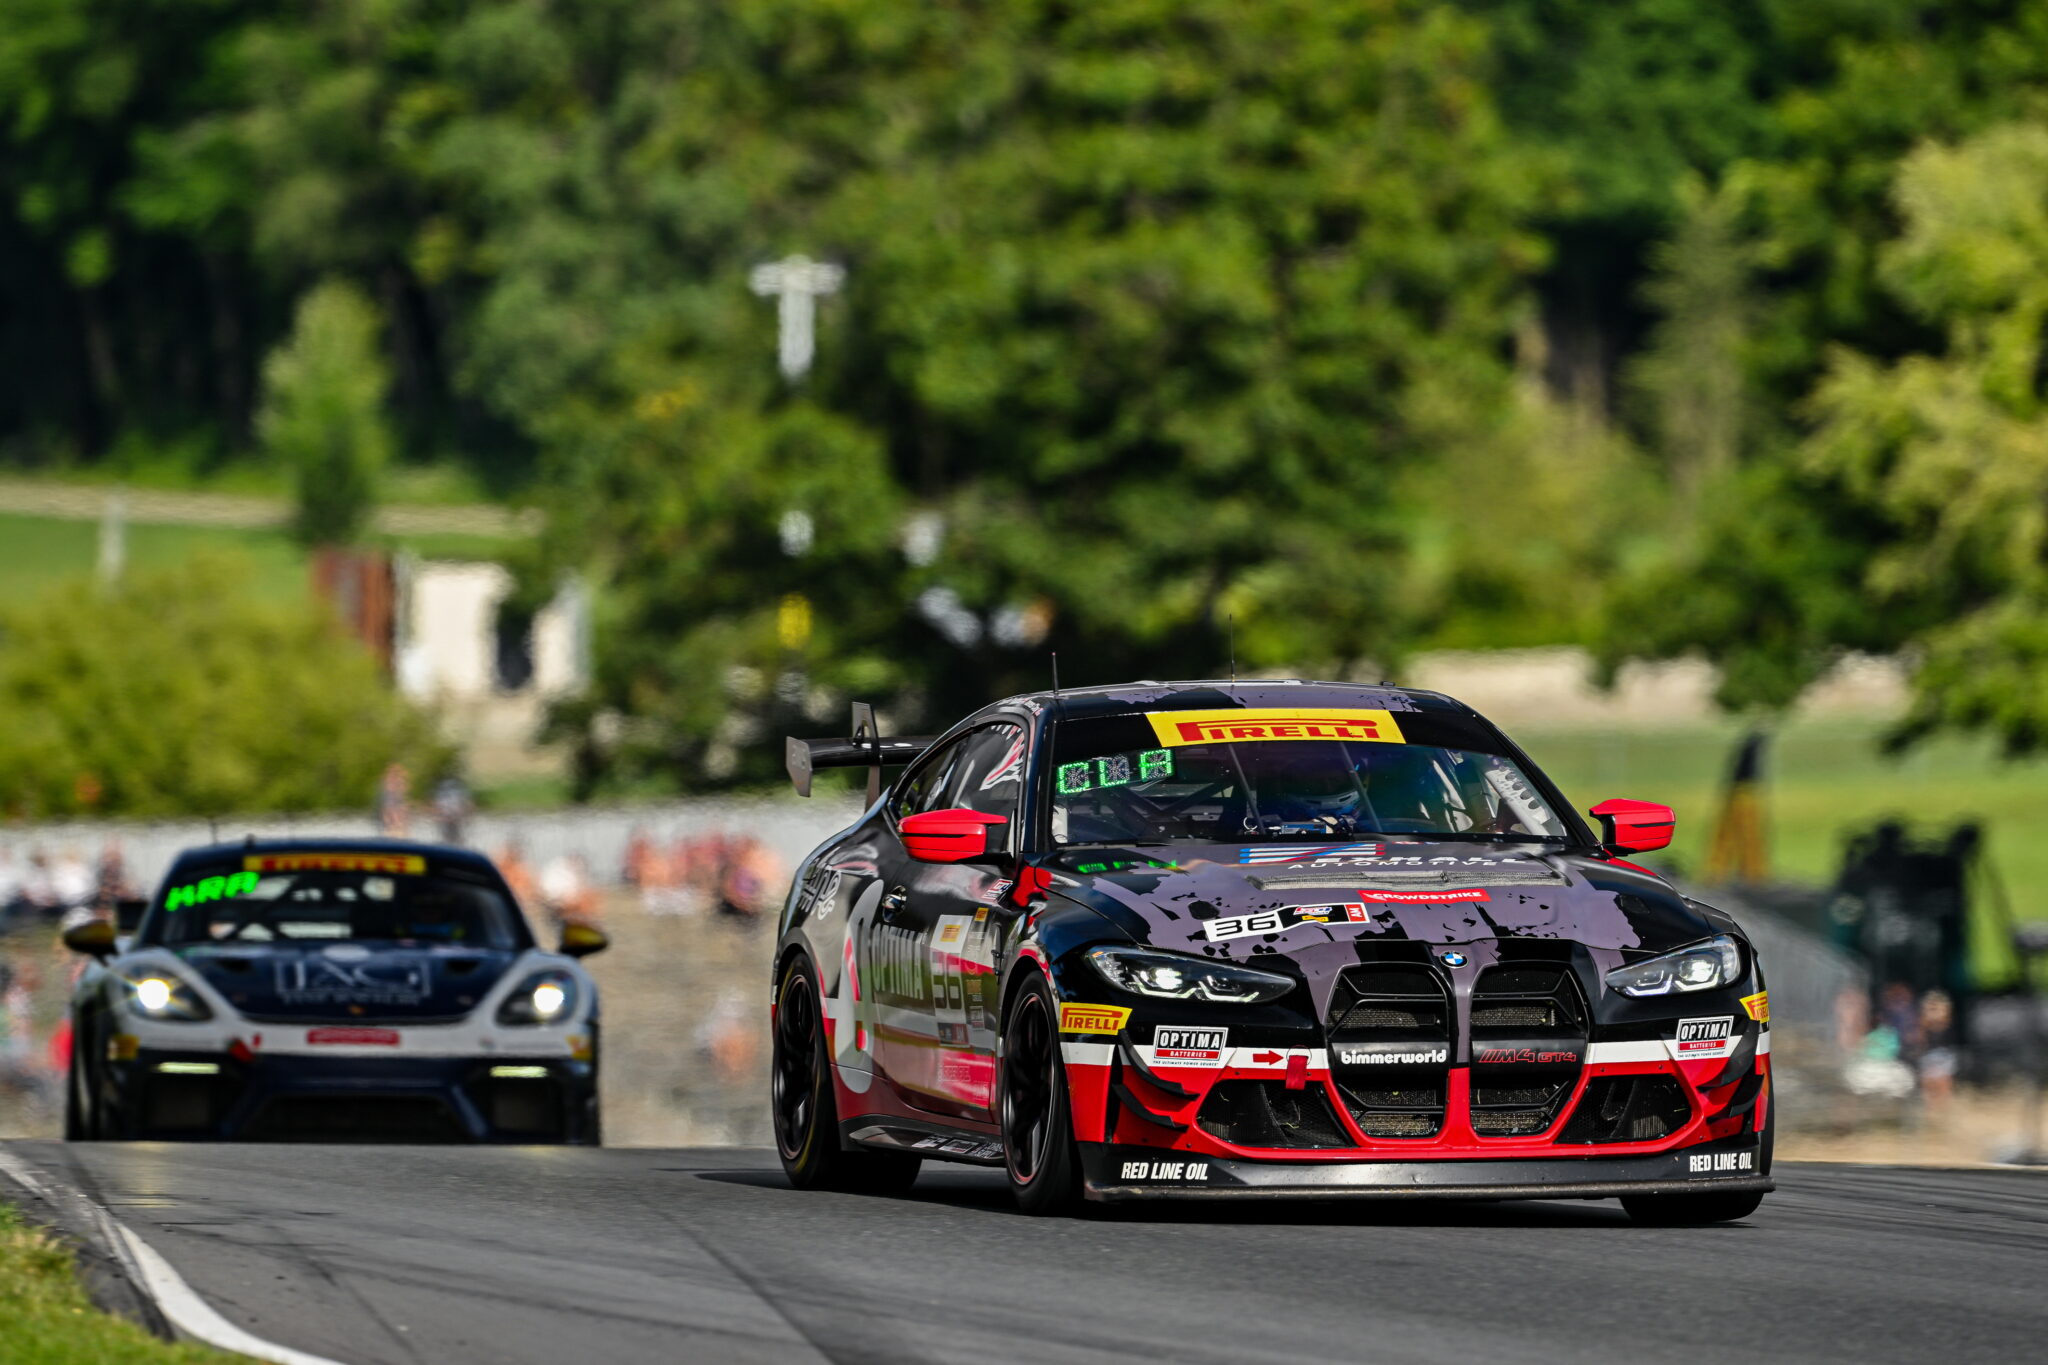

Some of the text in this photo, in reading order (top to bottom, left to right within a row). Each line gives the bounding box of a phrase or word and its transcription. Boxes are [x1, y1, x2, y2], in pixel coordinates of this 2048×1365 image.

[1175, 718, 1380, 742] PIRELLI
[1288, 861, 1499, 870] AUTOMOTIVE
[1372, 892, 1482, 900] CROWDSTRIKE
[1214, 914, 1277, 937] 36
[872, 923, 924, 1000] OPTIMA
[1062, 1007, 1123, 1031] PIRELLI
[1159, 1031, 1221, 1049] OPTIMA
[1681, 1022, 1727, 1040] OPTIMA
[1169, 1050, 1207, 1058] BATTERIES
[1341, 1049, 1447, 1064] bimmerworld
[1537, 1051, 1577, 1062] GT4
[1121, 1162, 1208, 1181] RED LINE OIL
[1689, 1152, 1752, 1173] RED LINE OIL
